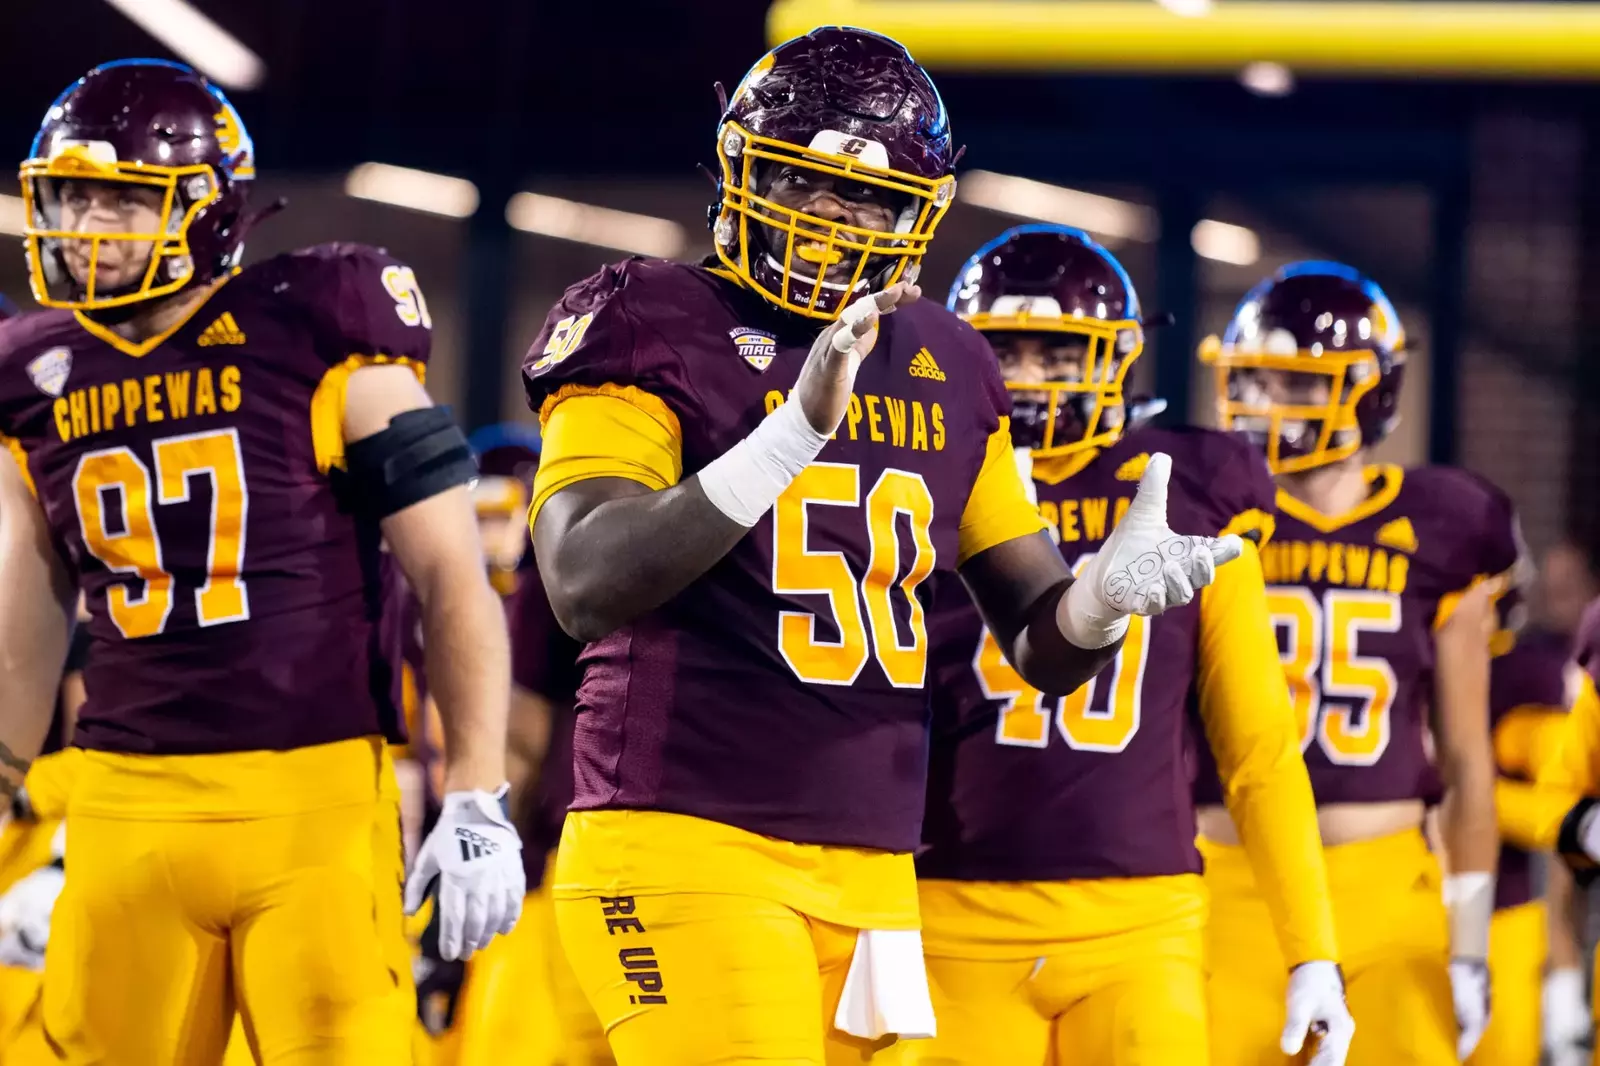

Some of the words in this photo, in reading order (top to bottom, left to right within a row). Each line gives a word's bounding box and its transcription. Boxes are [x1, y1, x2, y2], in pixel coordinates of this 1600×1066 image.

[794, 293, 828, 308] Ridll.
[531, 311, 594, 371] 50
[738, 344, 777, 356] MAC
[908, 363, 947, 382] adidas
[53, 365, 242, 443] CHIPPEWAS
[764, 389, 946, 452] PEWAS
[72, 427, 250, 639] 97
[772, 461, 936, 690] 50
[1260, 540, 1410, 595] HIPPEWAS
[618, 947, 668, 1005] UP!
